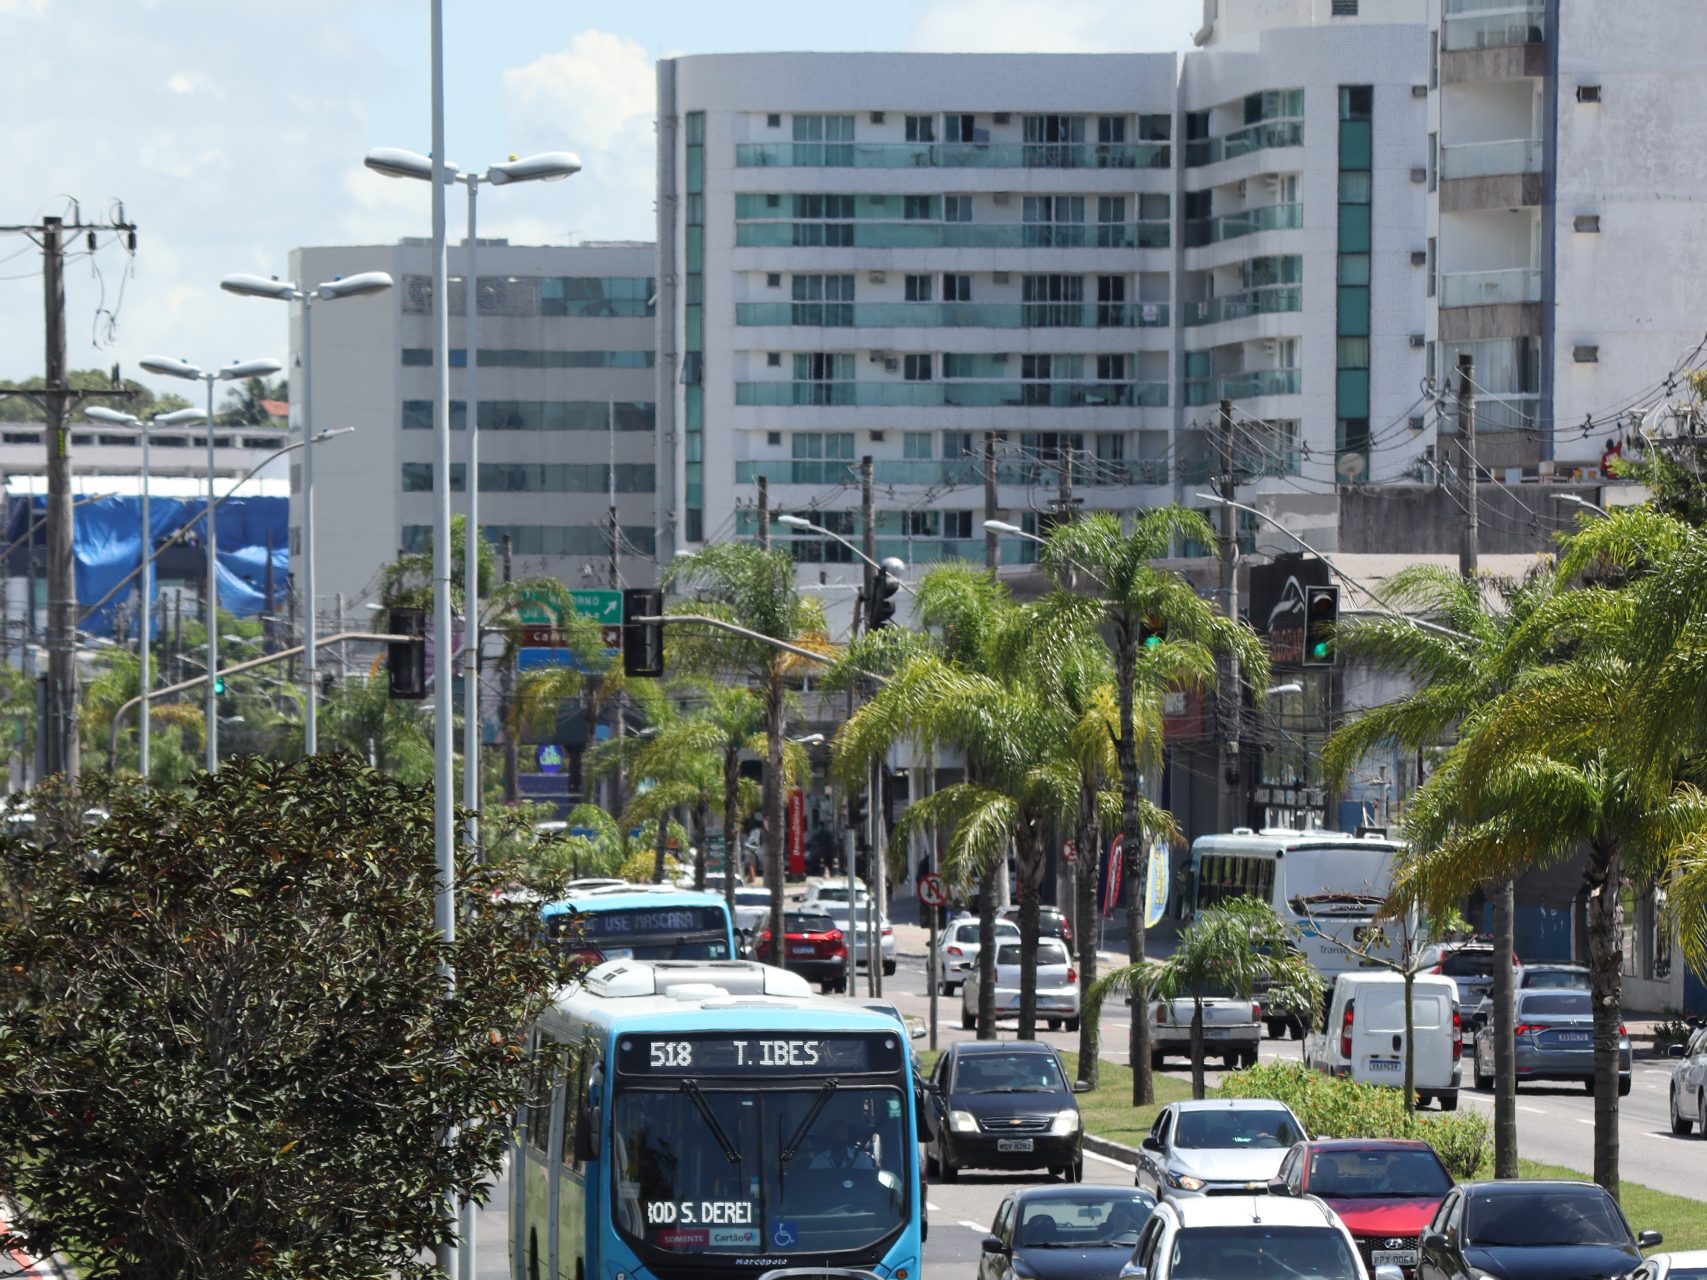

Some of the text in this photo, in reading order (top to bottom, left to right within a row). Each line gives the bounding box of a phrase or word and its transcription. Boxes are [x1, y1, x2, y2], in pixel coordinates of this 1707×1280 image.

[650, 1041, 819, 1067] 518 T. IBES
[663, 1234, 704, 1243] SOMENTE
